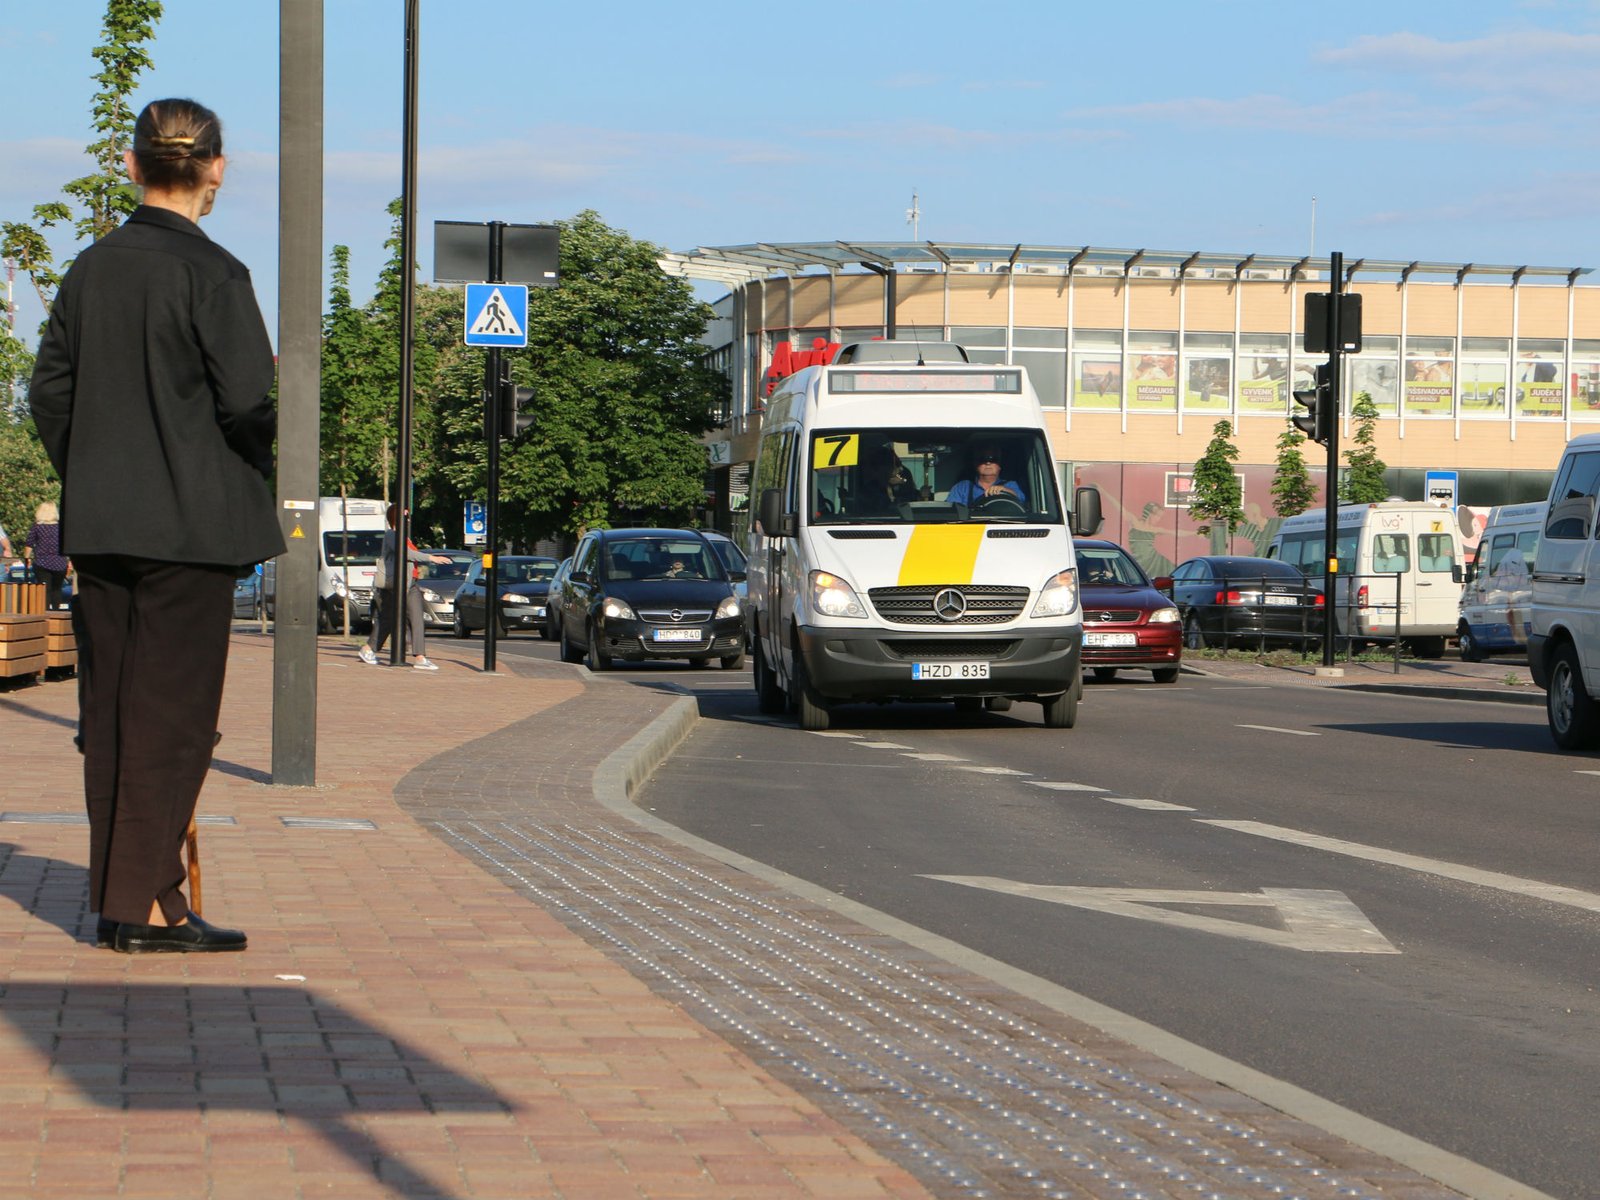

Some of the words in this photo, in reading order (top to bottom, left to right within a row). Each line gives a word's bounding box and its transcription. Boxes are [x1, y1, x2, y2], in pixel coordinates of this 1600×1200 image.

[823, 435, 851, 466] 7
[471, 503, 481, 520] P
[1433, 521, 1441, 531] 7
[684, 630, 700, 639] 840
[921, 665, 952, 677] HZD
[961, 664, 987, 677] 835
